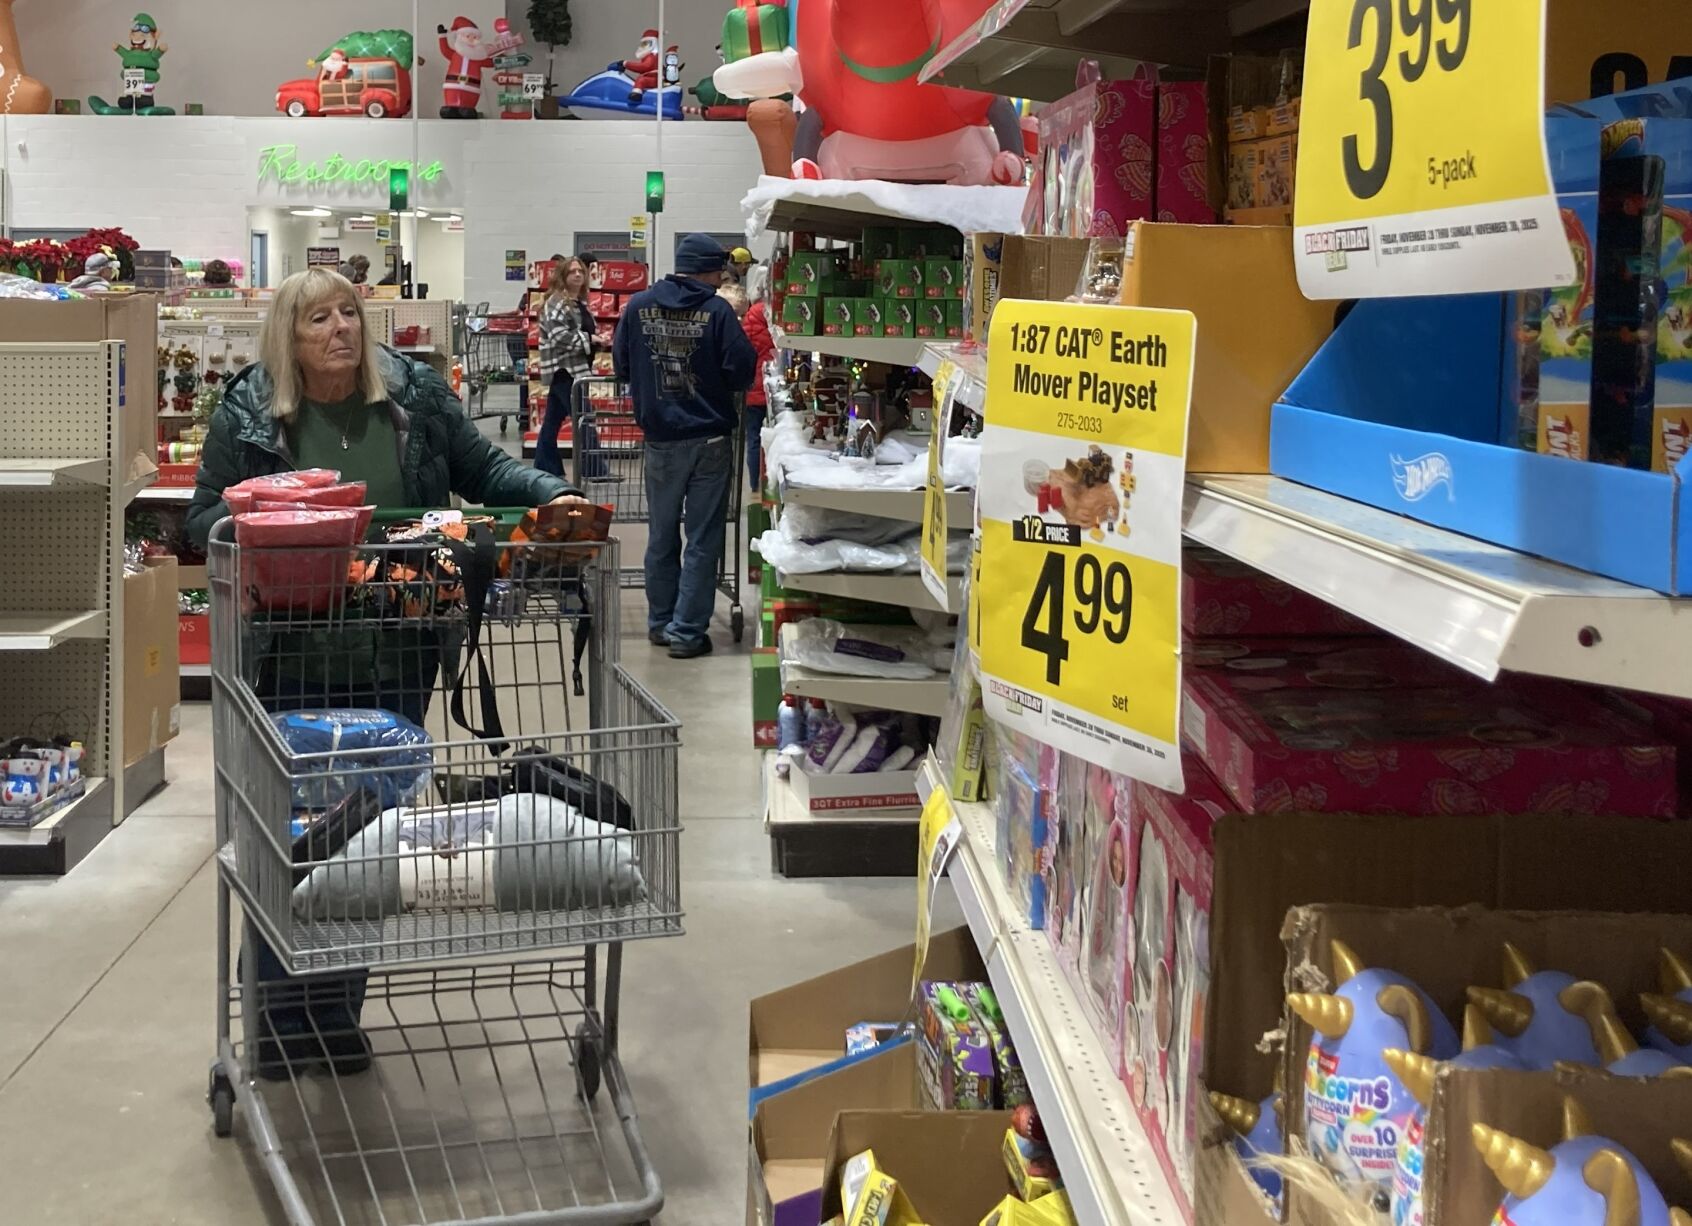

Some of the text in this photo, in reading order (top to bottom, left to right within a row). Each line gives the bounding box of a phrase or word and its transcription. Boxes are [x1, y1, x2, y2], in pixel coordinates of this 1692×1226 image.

[258, 143, 445, 182] Restroos
[1428, 149, 1478, 190] 5-pack
[1335, 226, 1370, 252] FRIDAY
[1011, 322, 1050, 355] 1:87
[1110, 331, 1167, 367] Earth
[1013, 363, 1157, 413] Mover Playset
[1057, 412, 1102, 433] 275-2033
[171, 474, 196, 482] RIBBO
[1022, 515, 1069, 543] 1/2 PRICE
[1014, 689, 1042, 713] FRIDAY
[1112, 694, 1128, 712] set
[835, 799, 860, 808] Extra
[863, 797, 883, 806] Fine
[886, 796, 918, 805] Flurrie
[1351, 1126, 1397, 1146] OVER 10
